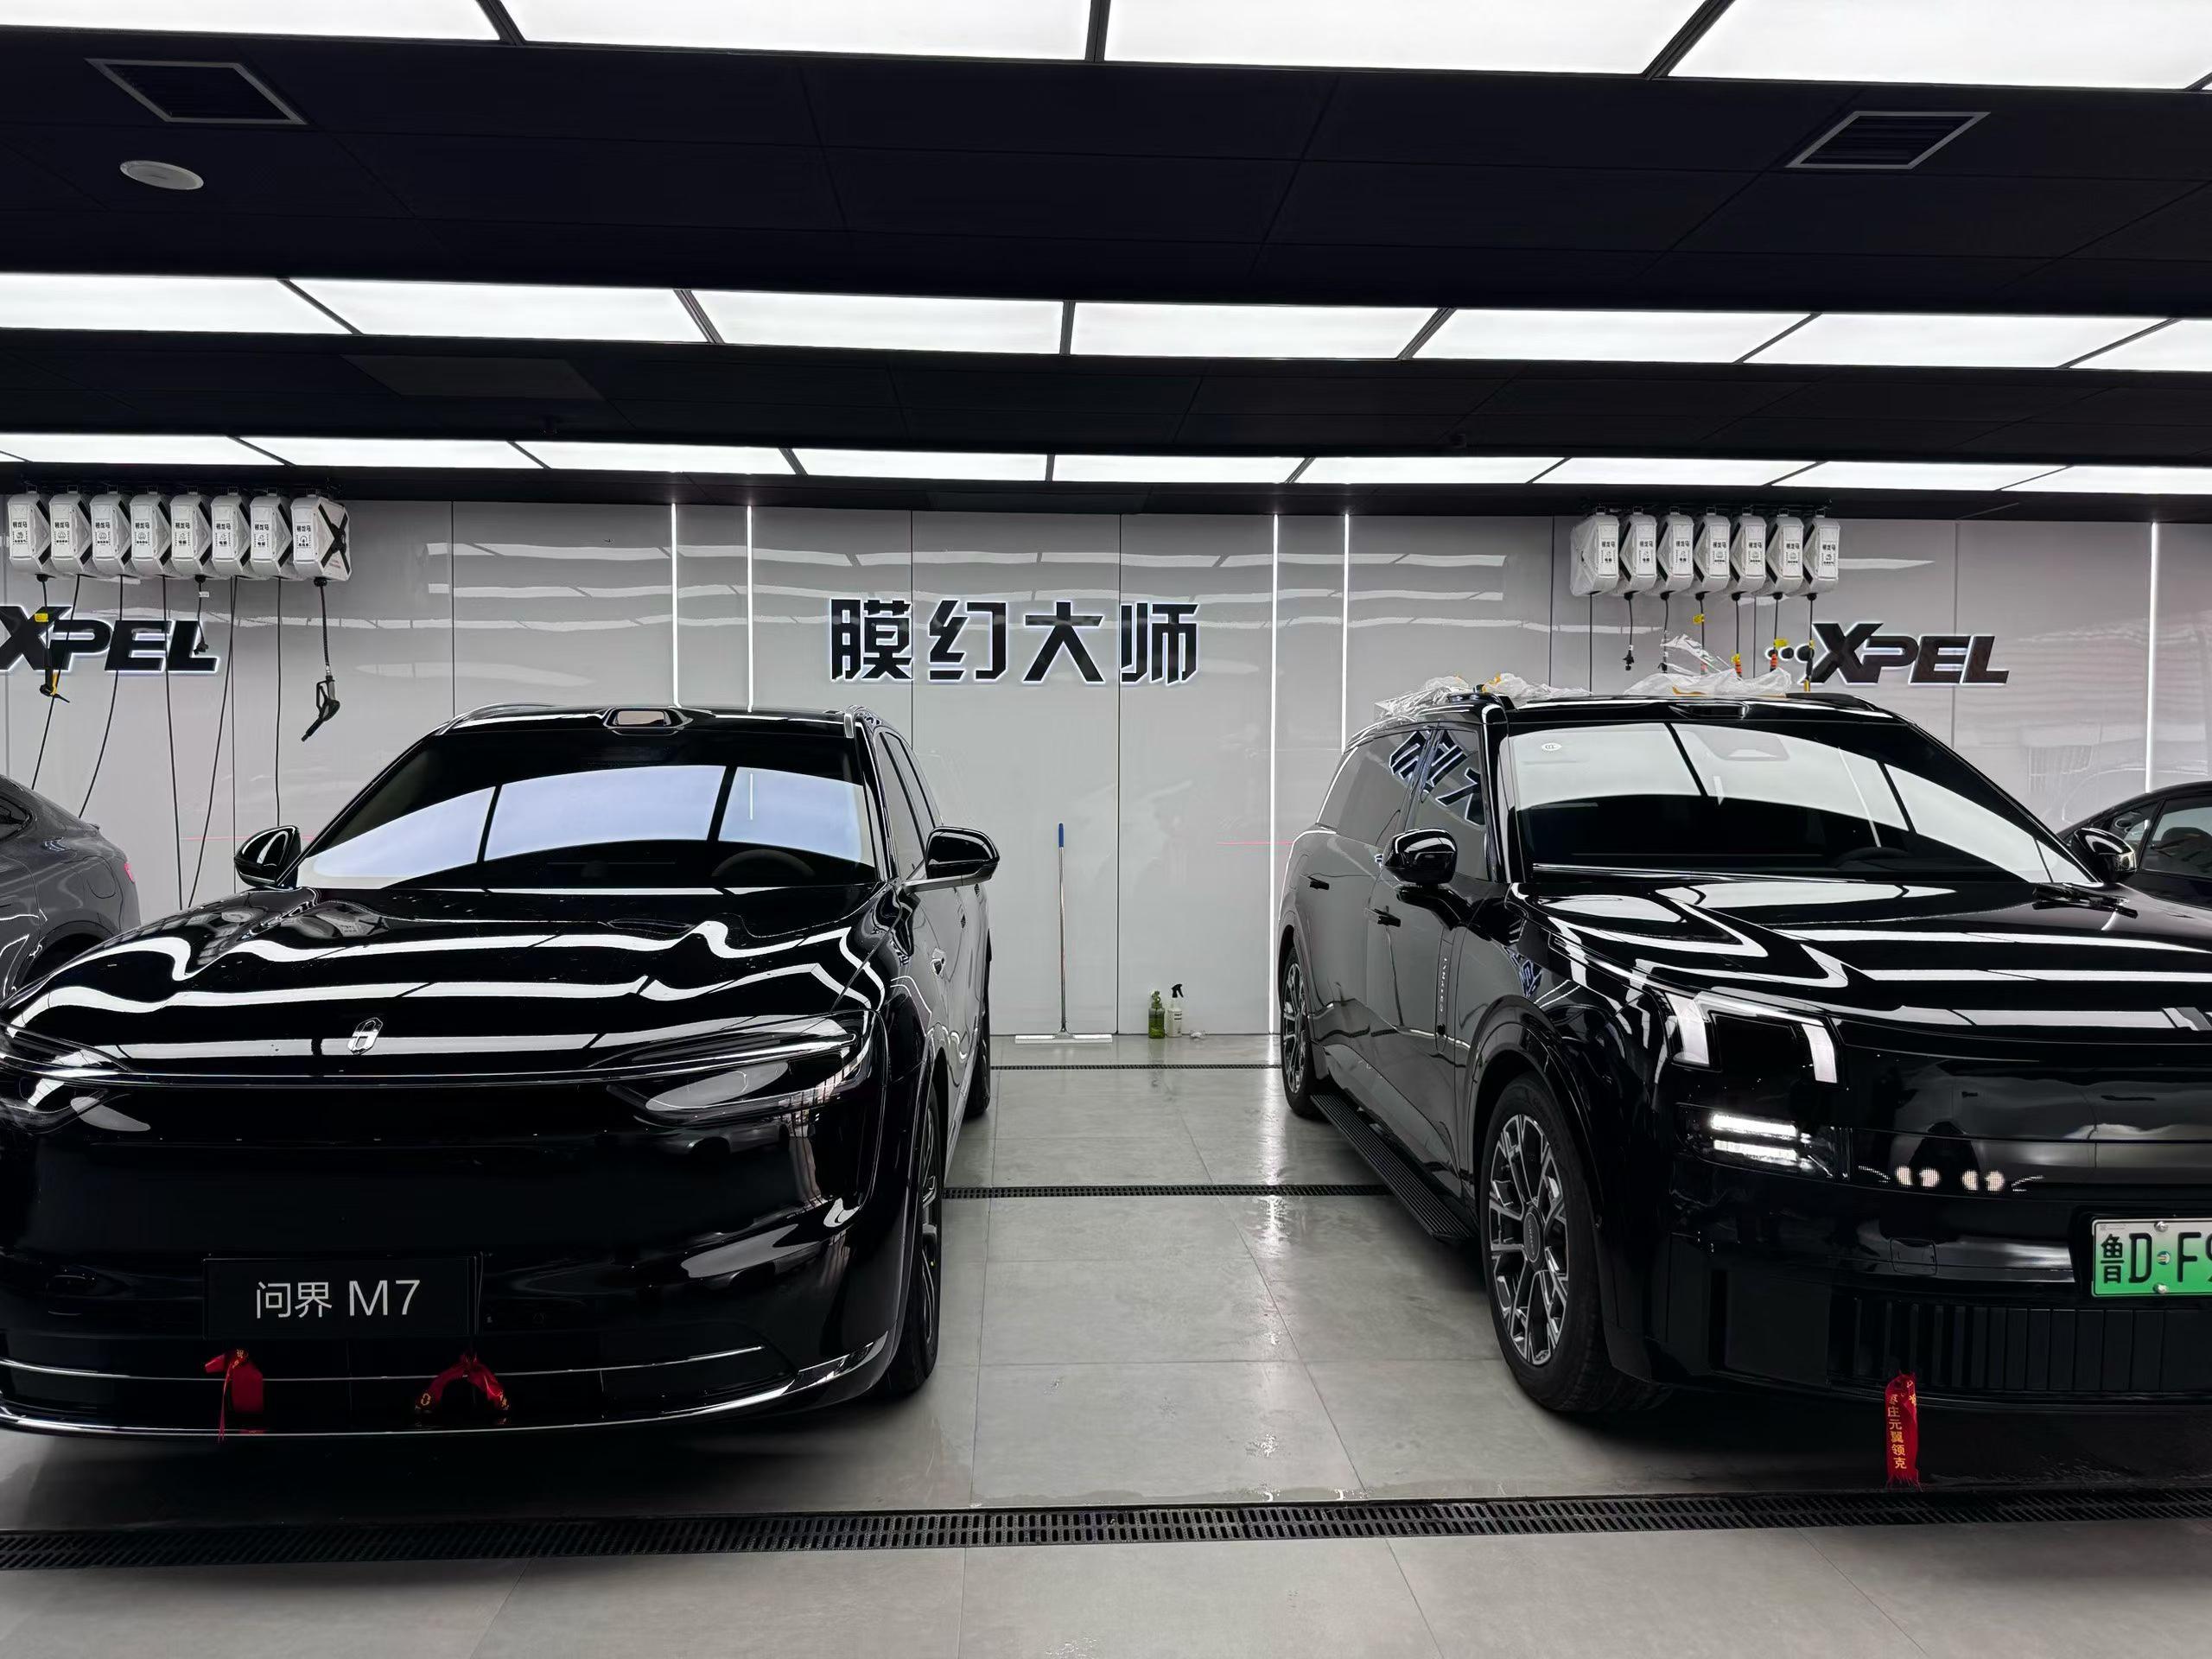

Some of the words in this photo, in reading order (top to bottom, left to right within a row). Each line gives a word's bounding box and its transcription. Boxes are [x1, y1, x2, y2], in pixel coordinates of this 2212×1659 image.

[0, 605, 218, 672] XPEL
[830, 598, 1199, 684] 膜幻大师
[1800, 622, 2011, 684] XPEL
[256, 1281, 333, 1319] 问界
[348, 1279, 421, 1317] M7
